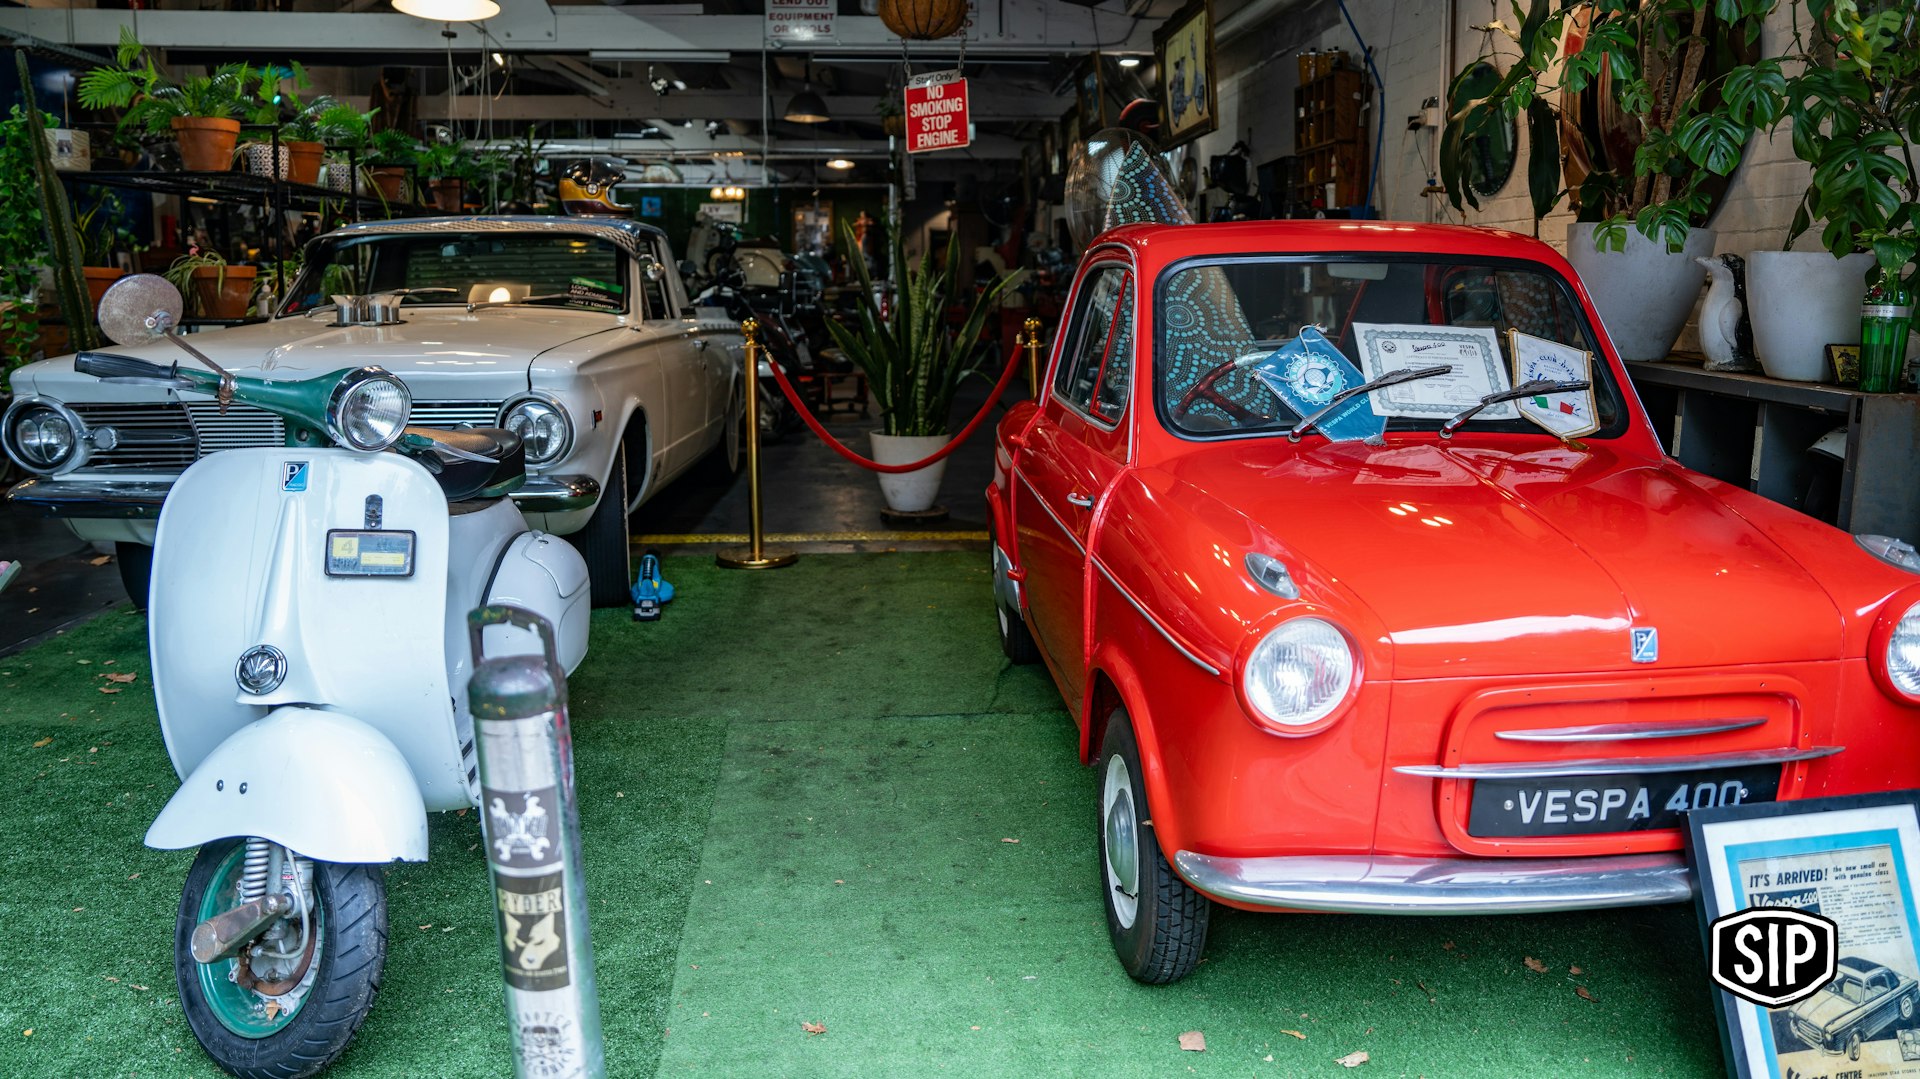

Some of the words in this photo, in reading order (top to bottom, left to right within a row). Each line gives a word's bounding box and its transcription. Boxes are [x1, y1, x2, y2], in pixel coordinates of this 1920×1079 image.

[769, 12, 835, 20] EQUIPMENT
[915, 75, 934, 85] Staff
[935, 72, 953, 82] Only
[926, 85, 944, 100] NO
[909, 97, 963, 118] SMOKING
[921, 114, 952, 132] STOP
[917, 129, 958, 148] ENGINE
[1324, 416, 1343, 429] VESPA
[1343, 403, 1361, 418] WORLD
[286, 464, 299, 481] P
[1518, 787, 1650, 824] VESPA
[1665, 780, 1743, 812] 400
[1860, 862, 1876, 870] small
[1750, 874, 1770, 888] IT'S
[1776, 868, 1829, 886] ARRIVED!
[1834, 873, 1847, 881] with
[1850, 871, 1872, 880] genuine
[1875, 869, 1889, 877] class
[1802, 890, 1819, 904] 400
[1835, 1069, 1863, 1079] CENTRE
